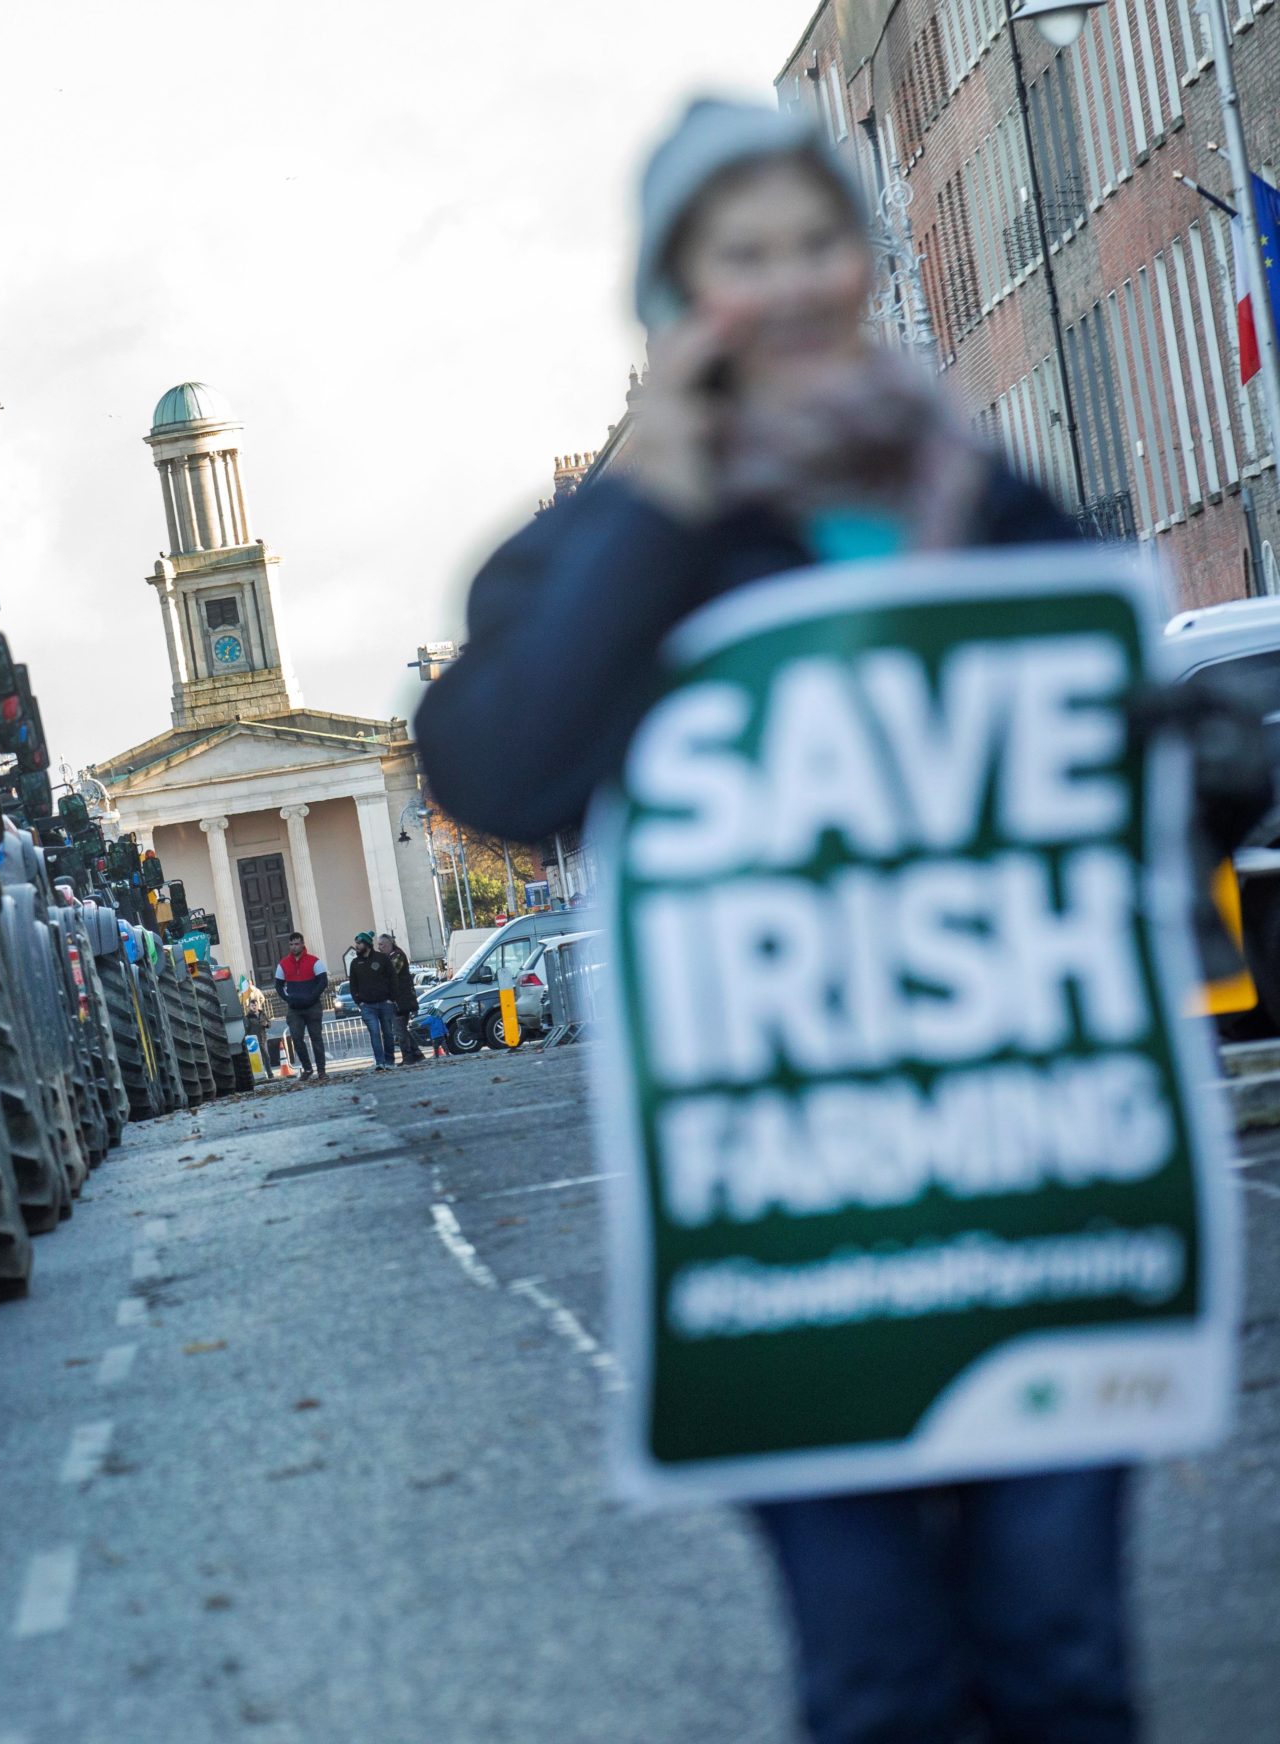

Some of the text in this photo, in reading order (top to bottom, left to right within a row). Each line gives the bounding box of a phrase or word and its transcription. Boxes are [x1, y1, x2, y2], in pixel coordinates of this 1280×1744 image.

[625, 635, 1130, 878] SAVE
[642, 847, 1156, 1084] IRISH
[660, 1053, 1173, 1225] FARMING
